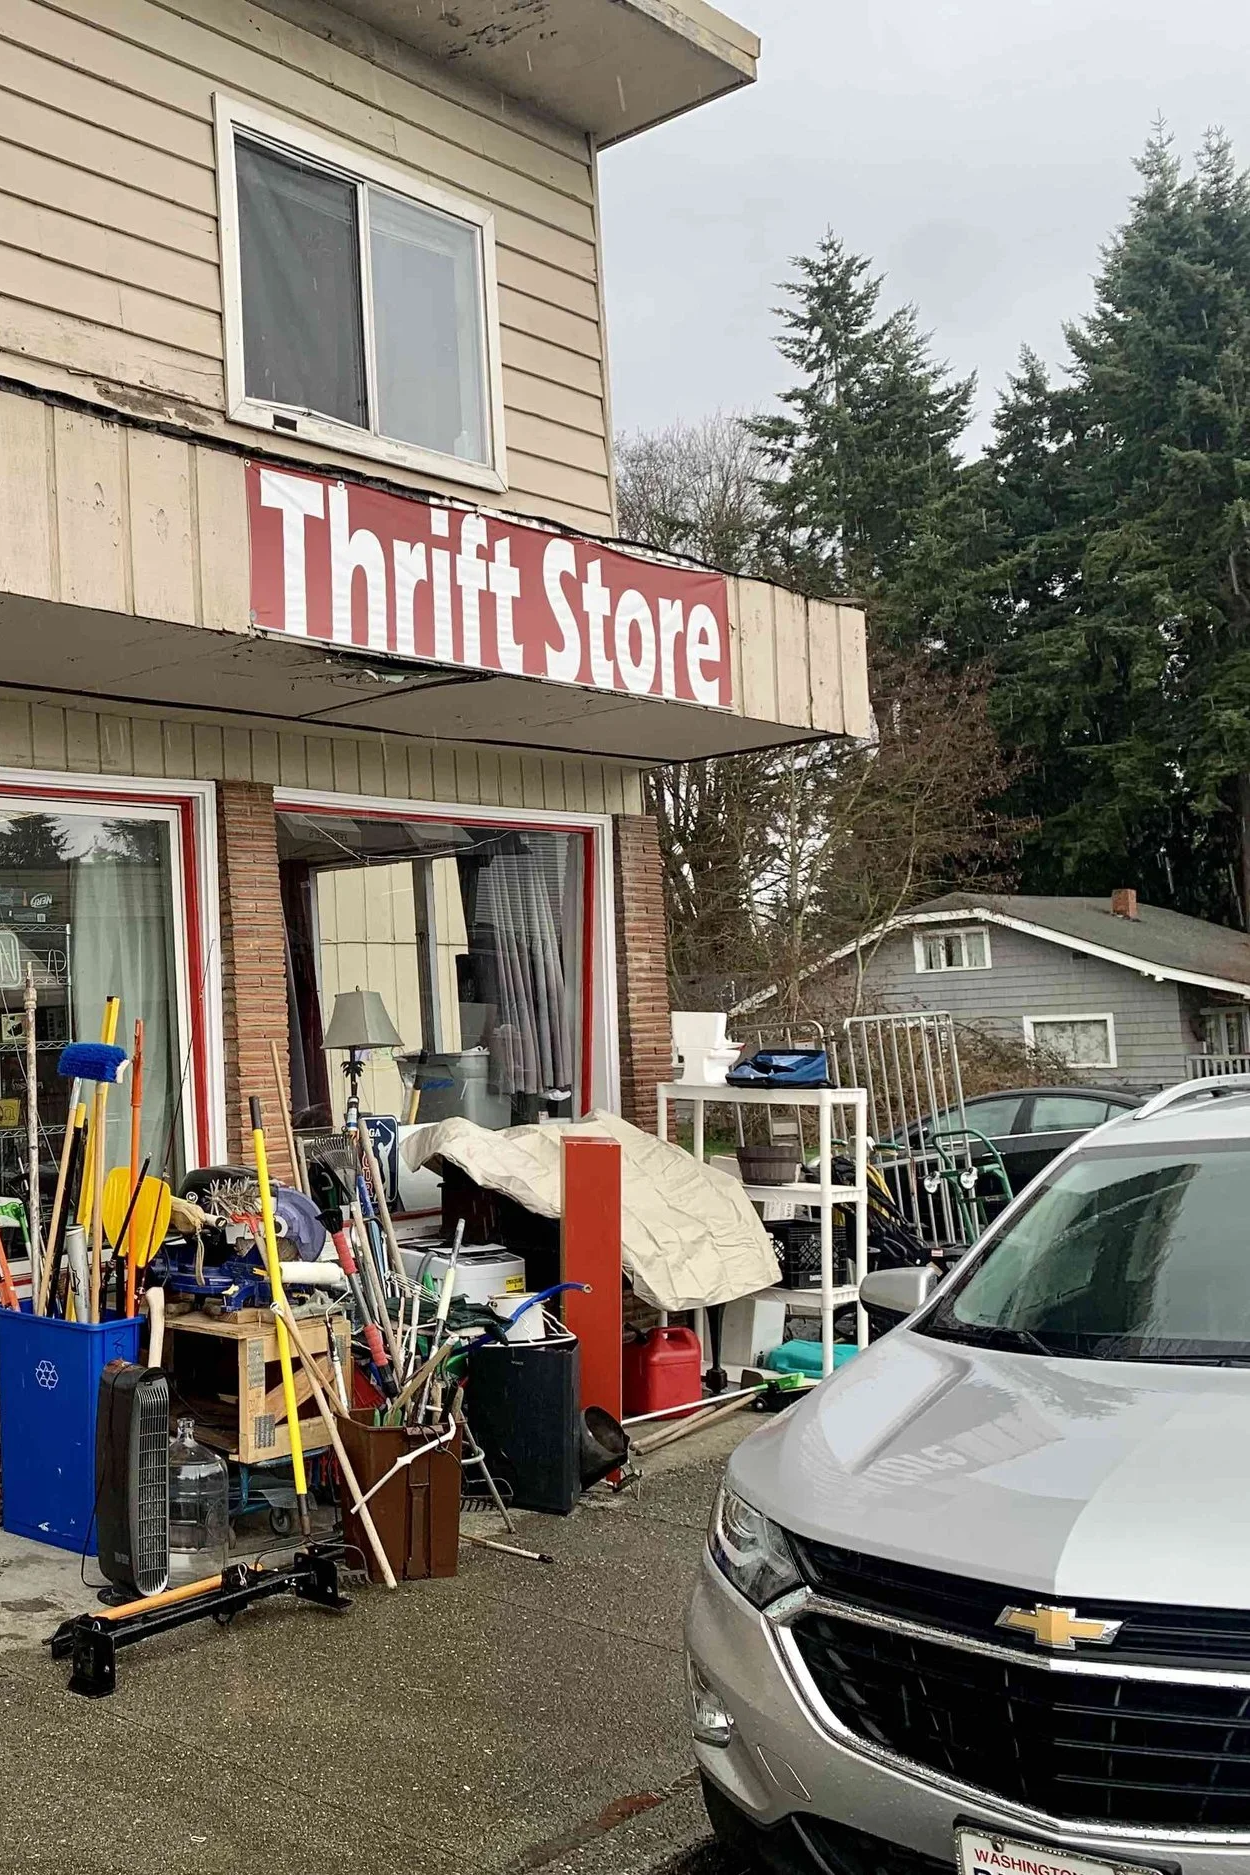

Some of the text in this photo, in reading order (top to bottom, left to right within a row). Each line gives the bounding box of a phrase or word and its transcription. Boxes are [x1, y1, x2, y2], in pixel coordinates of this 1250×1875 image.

[260, 468, 721, 706] Thrift Store
[31, 892, 53, 908] NERF
[368, 1128, 381, 1137] GA
[974, 1848, 1084, 1875] WASHINGT
